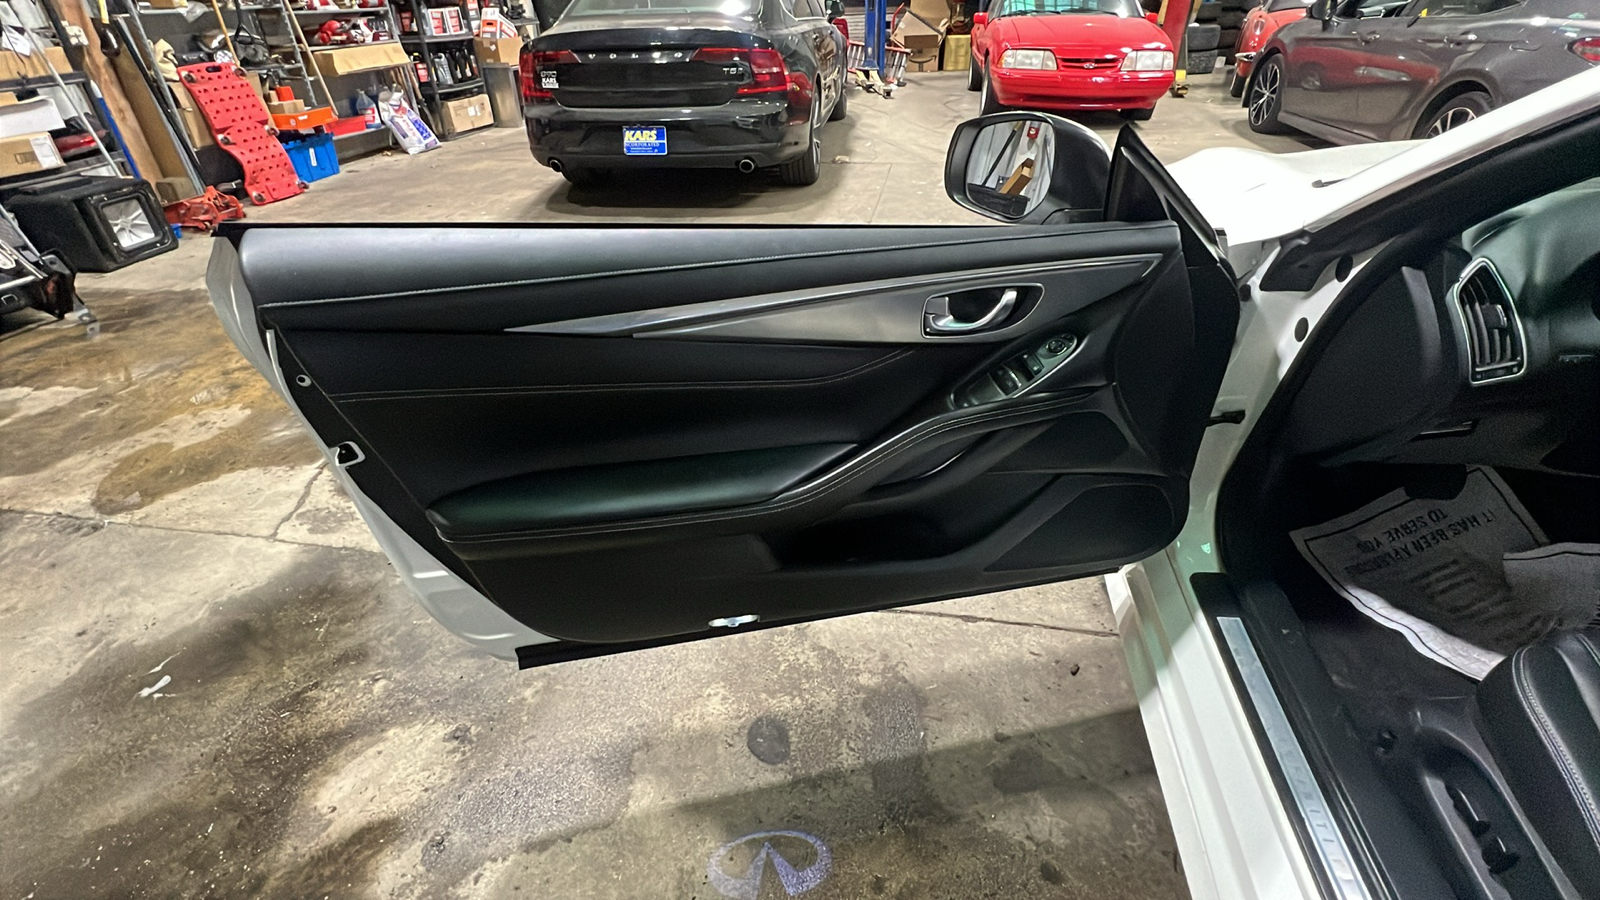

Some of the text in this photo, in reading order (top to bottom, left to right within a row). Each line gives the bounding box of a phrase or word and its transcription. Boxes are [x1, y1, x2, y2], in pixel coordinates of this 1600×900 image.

[625, 130, 657, 141] KARS
[1427, 507, 1448, 524] TO
[1448, 514, 1482, 537] HAS
[1482, 508, 1497, 524] IT
[1382, 514, 1428, 544] SERVE
[1412, 528, 1448, 552] BEEN
